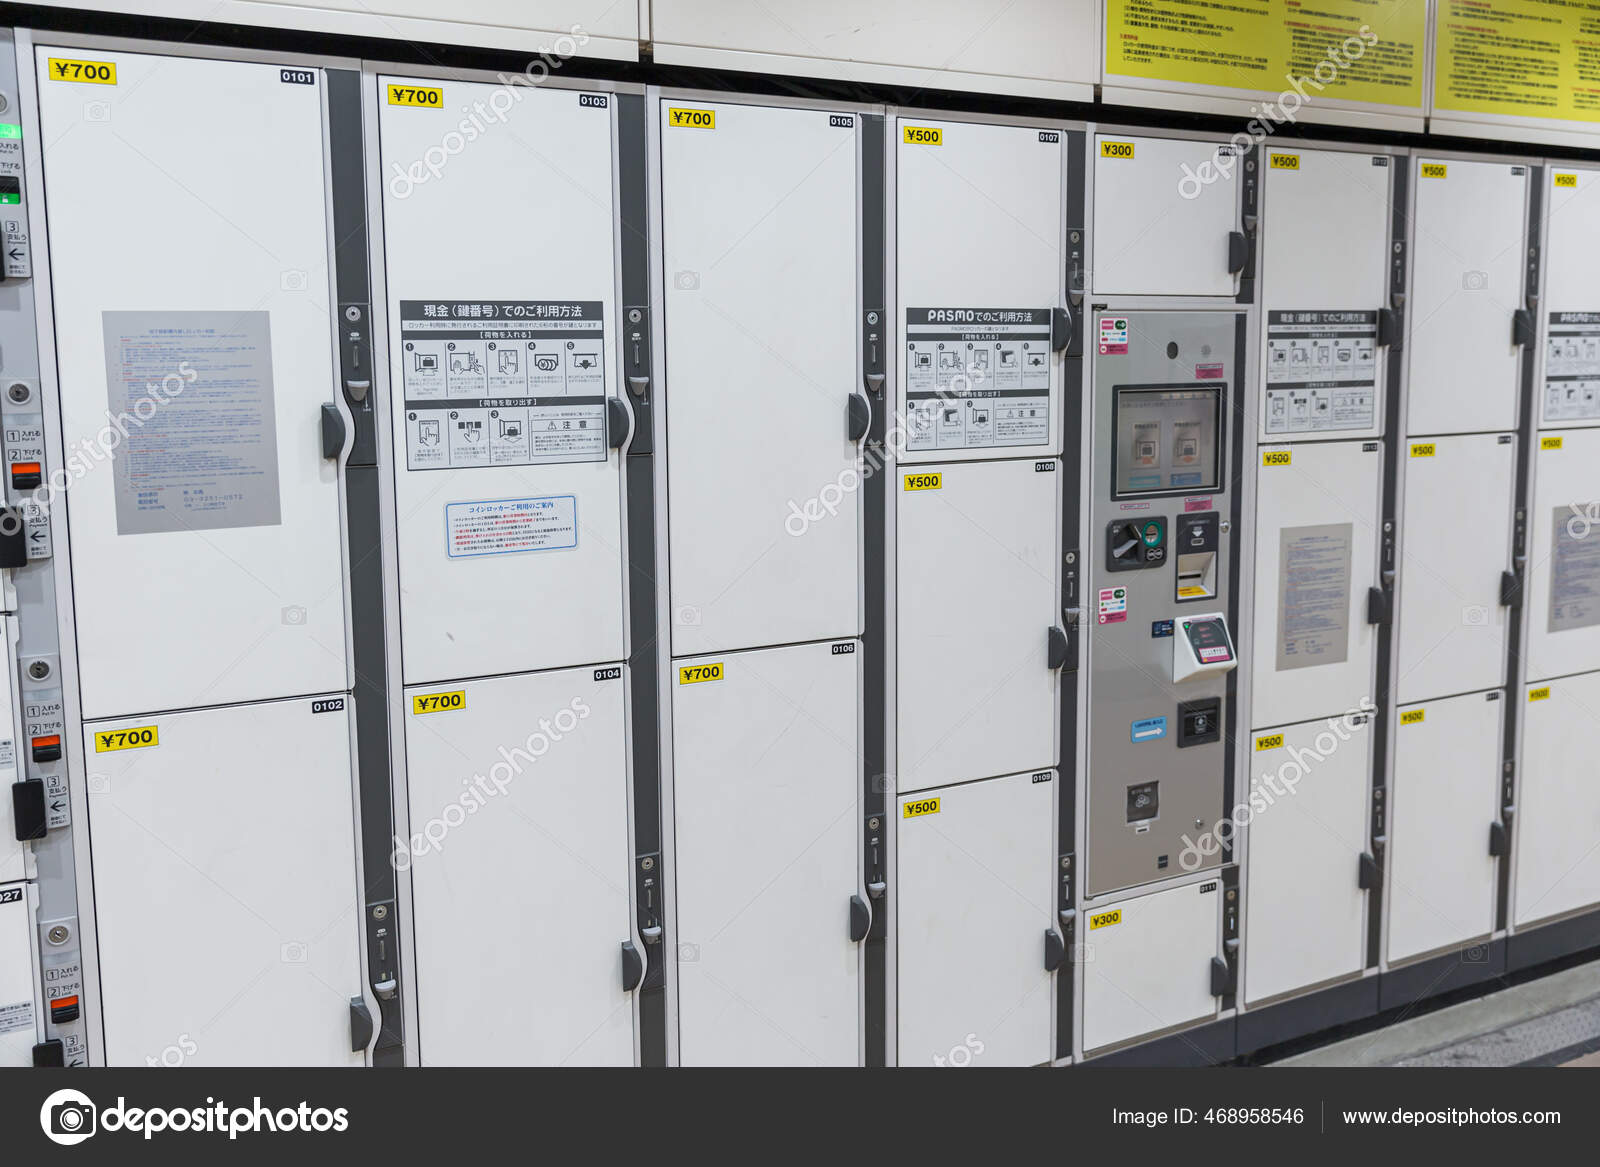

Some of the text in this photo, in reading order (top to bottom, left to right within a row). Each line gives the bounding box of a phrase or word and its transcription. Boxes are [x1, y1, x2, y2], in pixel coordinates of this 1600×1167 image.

[55, 63, 111, 81] ¥700
[283, 72, 313, 82] 0101
[392, 89, 439, 105] ¥700
[581, 97, 606, 107] 0103
[673, 111, 712, 126] ¥700
[831, 116, 852, 126] 0105
[907, 129, 939, 143] ¥500
[1040, 133, 1058, 142] 0107
[1104, 143, 1132, 156] ¥300
[1273, 156, 1297, 168] ¥500
[424, 304, 583, 318] 現金（鍵番号）でのご利用方法
[928, 310, 1033, 322] PASMOでのご利用方法
[1266, 454, 1289, 464] ¥500
[1037, 463, 1054, 471] 0108
[907, 476, 938, 488] ¥500
[833, 644, 853, 653] 0106
[596, 669, 619, 679] 0104
[683, 666, 720, 681] ¥700
[314, 700, 342, 712] 0102
[418, 695, 461, 711] ¥700
[100, 729, 153, 748] ¥700
[1258, 736, 1281, 748] ¥500
[1034, 773, 1050, 783] 0109
[906, 800, 937, 815] ¥500
[1093, 912, 1119, 927] ¥300
